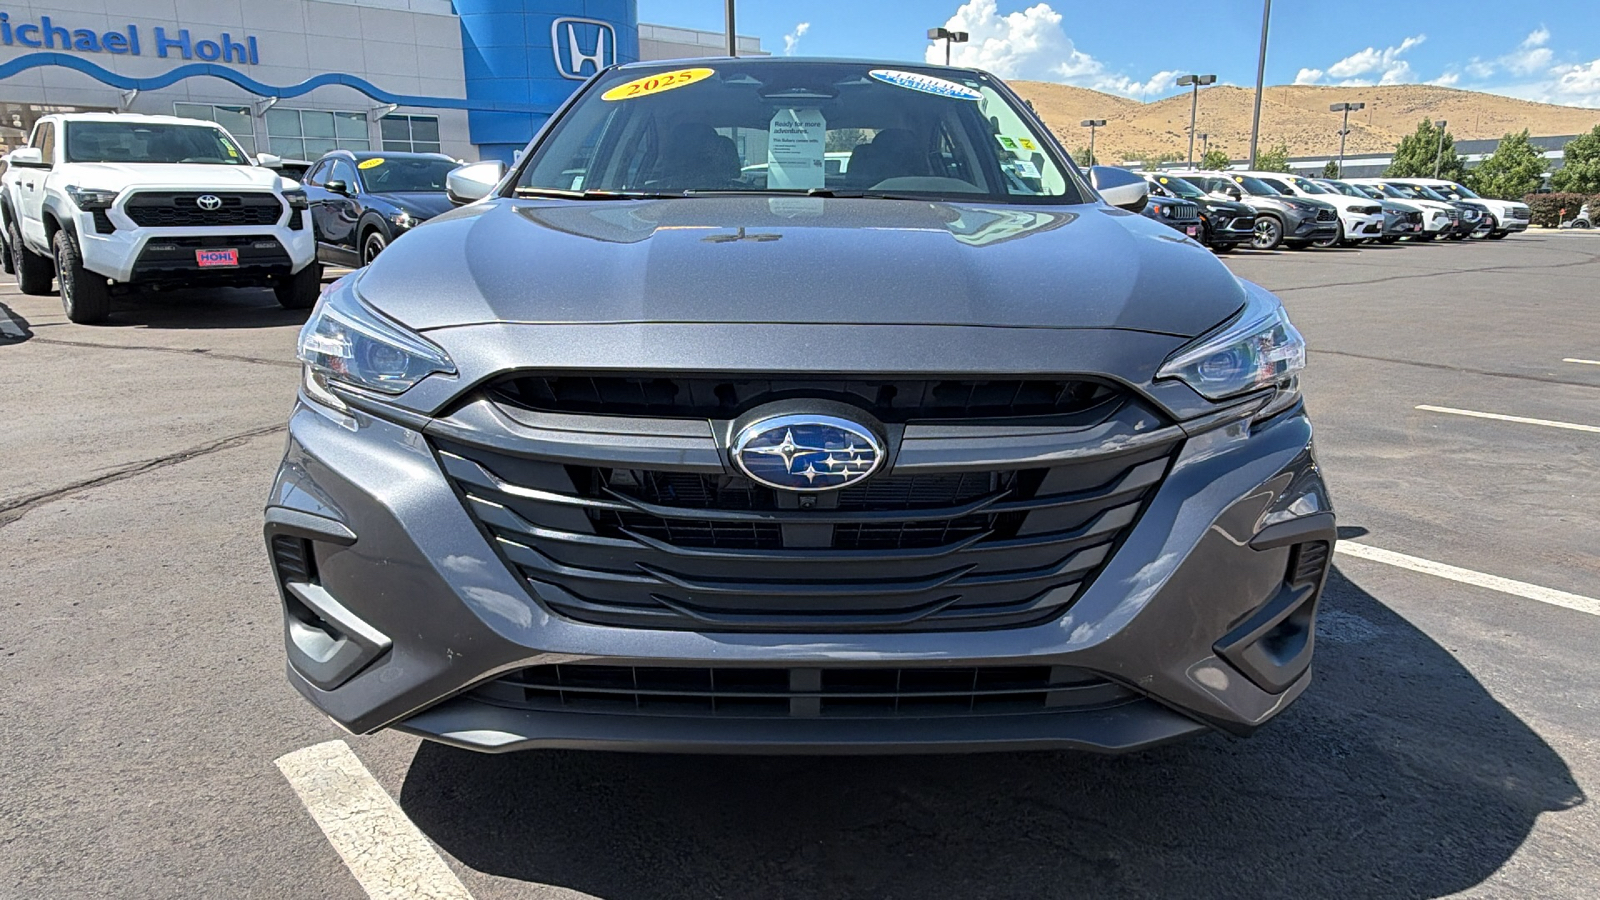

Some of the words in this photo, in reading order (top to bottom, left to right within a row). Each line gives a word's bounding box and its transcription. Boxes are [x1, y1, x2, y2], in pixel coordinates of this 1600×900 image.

[154, 26, 259, 65] Hohl
[627, 71, 692, 96] 2025
[201, 253, 233, 261] HOHL
